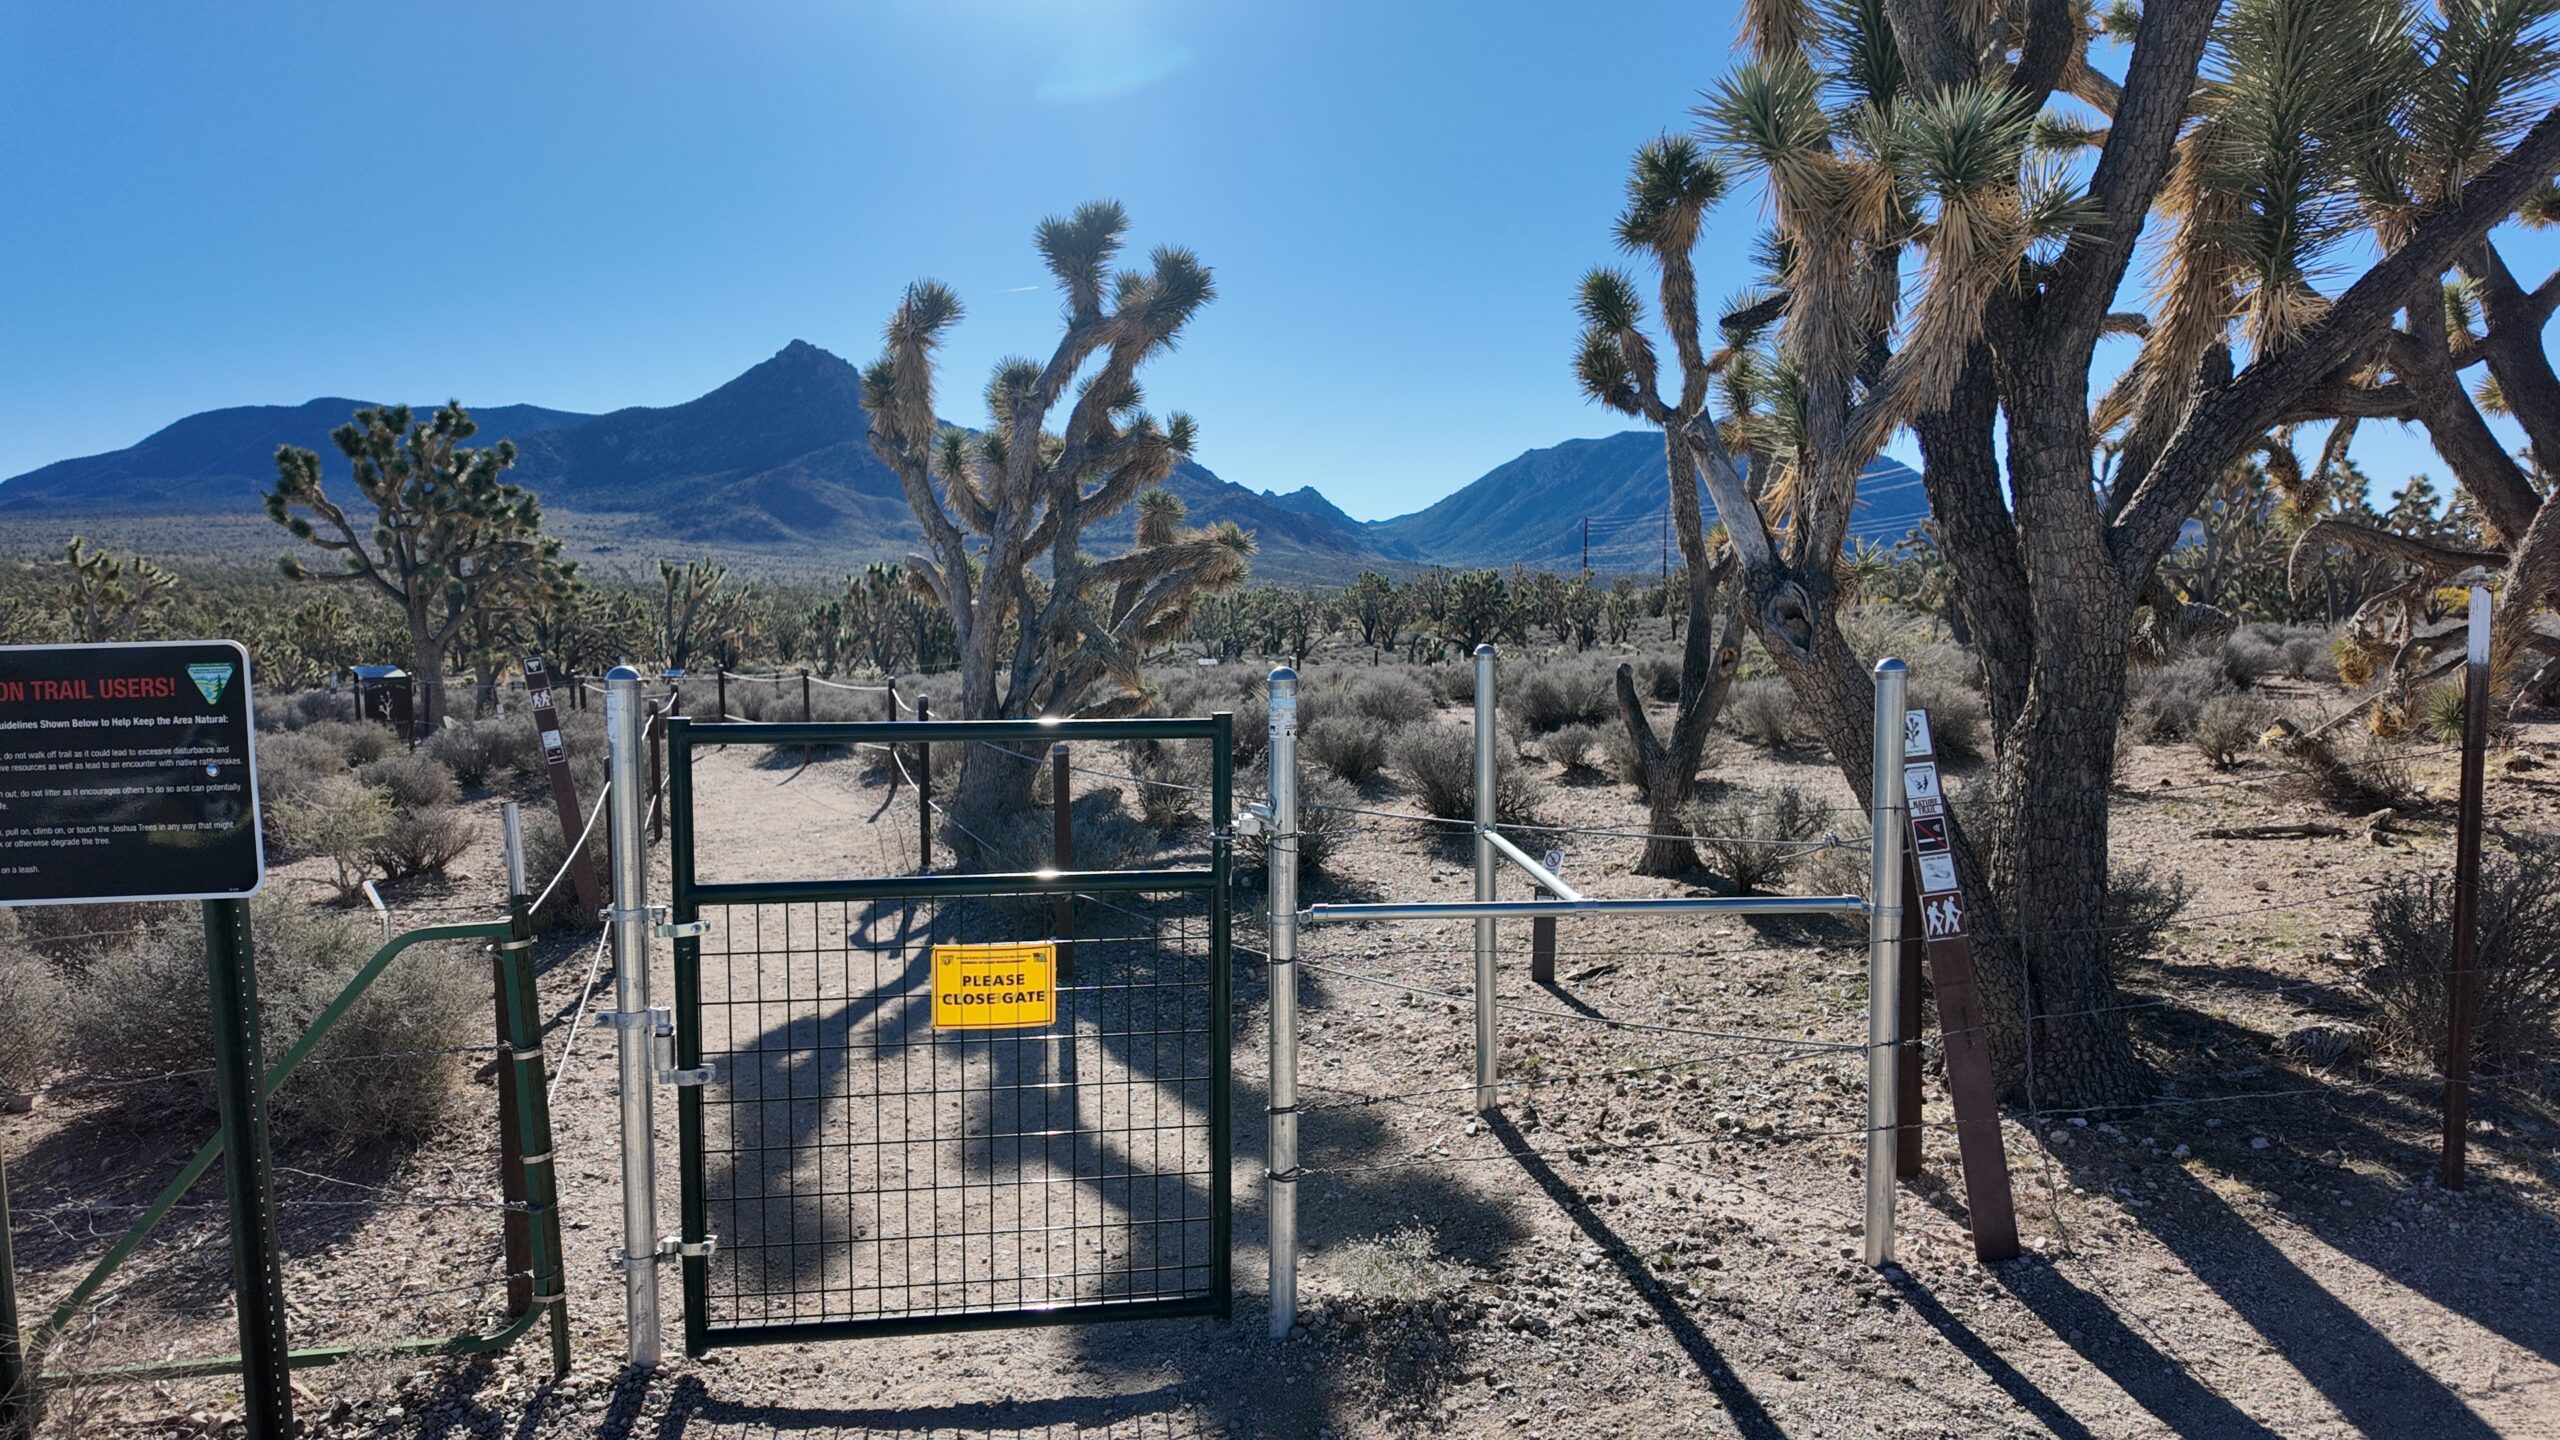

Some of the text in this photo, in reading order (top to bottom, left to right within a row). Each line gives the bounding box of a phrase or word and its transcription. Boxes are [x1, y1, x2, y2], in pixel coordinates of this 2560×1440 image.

[31, 680, 94, 702] TRAIL
[99, 677, 176, 699] USERS!
[40, 719, 70, 729] Shown
[72, 718, 99, 729] Below
[101, 718, 109, 728] to
[111, 717, 131, 729] Help
[133, 716, 155, 728] Keep
[156, 716, 170, 727] the
[172, 715, 193, 726] Area
[194, 714, 229, 725] Natural:
[4, 752, 13, 760] do
[15, 752, 27, 760] not
[28, 751, 46, 760] walk
[47, 750, 57, 759] off
[58, 750, 73, 759] trail
[84, 749, 90, 758] it
[91, 749, 111, 758] could
[112, 748, 128, 757] lead
[129, 748, 137, 756] to
[138, 748, 172, 756] excessive
[173, 746, 216, 755] disturbance
[216, 745, 230, 754] and
[58, 762, 74, 771] well
[85, 761, 101, 770] lead
[102, 761, 110, 769] to
[122, 760, 157, 769] encounter
[159, 759, 175, 768] with
[176, 758, 198, 767] native
[5, 790, 19, 799] out,
[20, 790, 30, 798] do
[31, 789, 43, 798] not
[45, 788, 61, 797] litter
[63, 789, 72, 797] as
[73, 788, 79, 796] it
[80, 787, 122, 797] encourages
[122, 786, 146, 795] others
[146, 785, 154, 794] to
[155, 785, 165, 794] do
[177, 784, 190, 793] and
[191, 785, 205, 793] can
[206, 783, 242, 793] potentially
[1913, 797, 1939, 809] NATURE
[1918, 805, 1938, 815] TRAIL
[5, 828, 19, 837] pull
[20, 829, 32, 837] on,
[33, 827, 54, 836] climb
[55, 827, 67, 836] on,
[67, 827, 76, 835] or
[77, 826, 97, 834] touch
[98, 825, 111, 834] the
[112, 824, 138, 833] Joshua
[138, 823, 158, 832] Trees
[159, 822, 166, 831] in
[167, 823, 181, 832] any
[182, 823, 197, 832] way
[198, 821, 213, 830] that
[214, 820, 235, 831] might
[14, 839, 49, 848] otherwise
[51, 838, 81, 848] degrade
[82, 837, 94, 846] the
[95, 837, 112, 845] tree.
[19, 864, 41, 874] leash.
[963, 974, 1025, 987] PLEASE
[942, 990, 1046, 1006] CLOSE GATE
